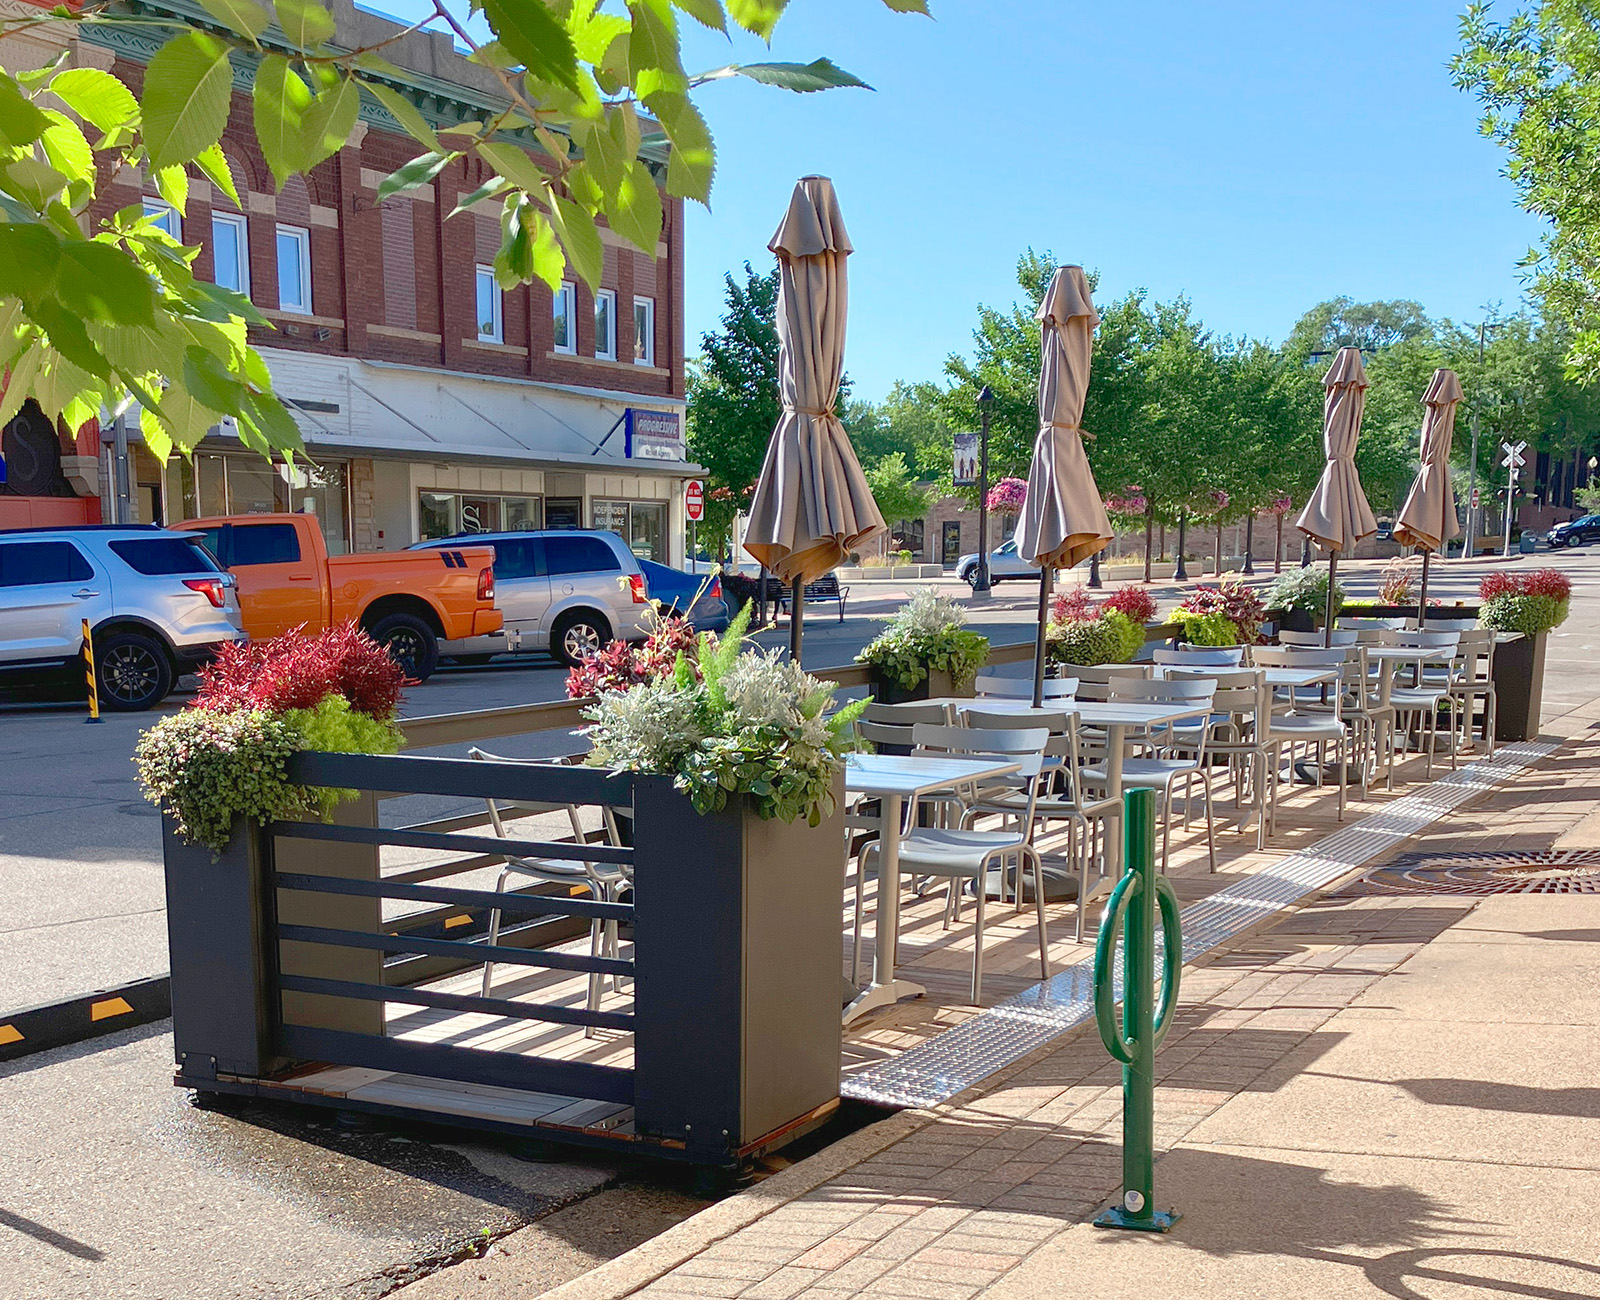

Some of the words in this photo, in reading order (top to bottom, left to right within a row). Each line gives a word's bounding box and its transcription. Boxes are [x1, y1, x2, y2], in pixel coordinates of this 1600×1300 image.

[638, 419, 678, 434] PROGRESSIVE
[593, 505, 627, 515] NDEPENDENT
[595, 517, 625, 526] INSURANCE
